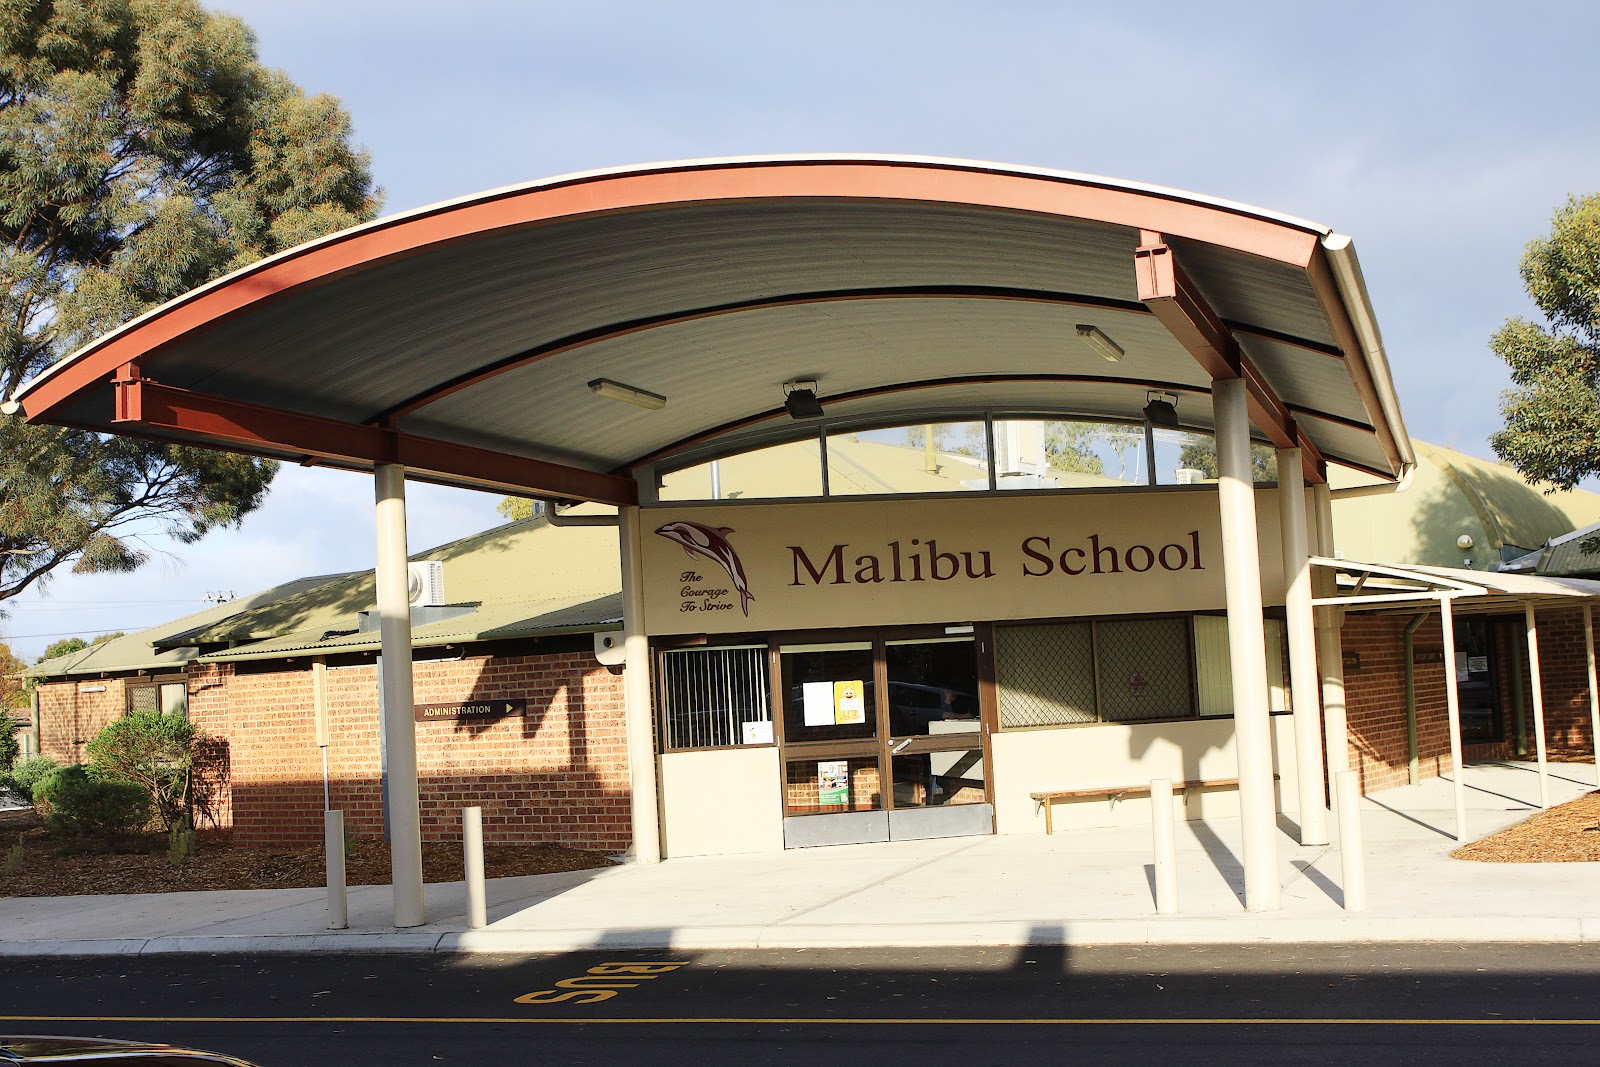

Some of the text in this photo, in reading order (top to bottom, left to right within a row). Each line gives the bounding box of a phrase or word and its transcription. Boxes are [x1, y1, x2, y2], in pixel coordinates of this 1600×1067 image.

[786, 530, 1205, 586] Malibu School
[680, 571, 703, 582] The
[680, 585, 729, 599] Courage
[680, 598, 734, 612] To Strive
[423, 705, 491, 717] ADMINISTRATION
[513, 961, 690, 1004] BUS
